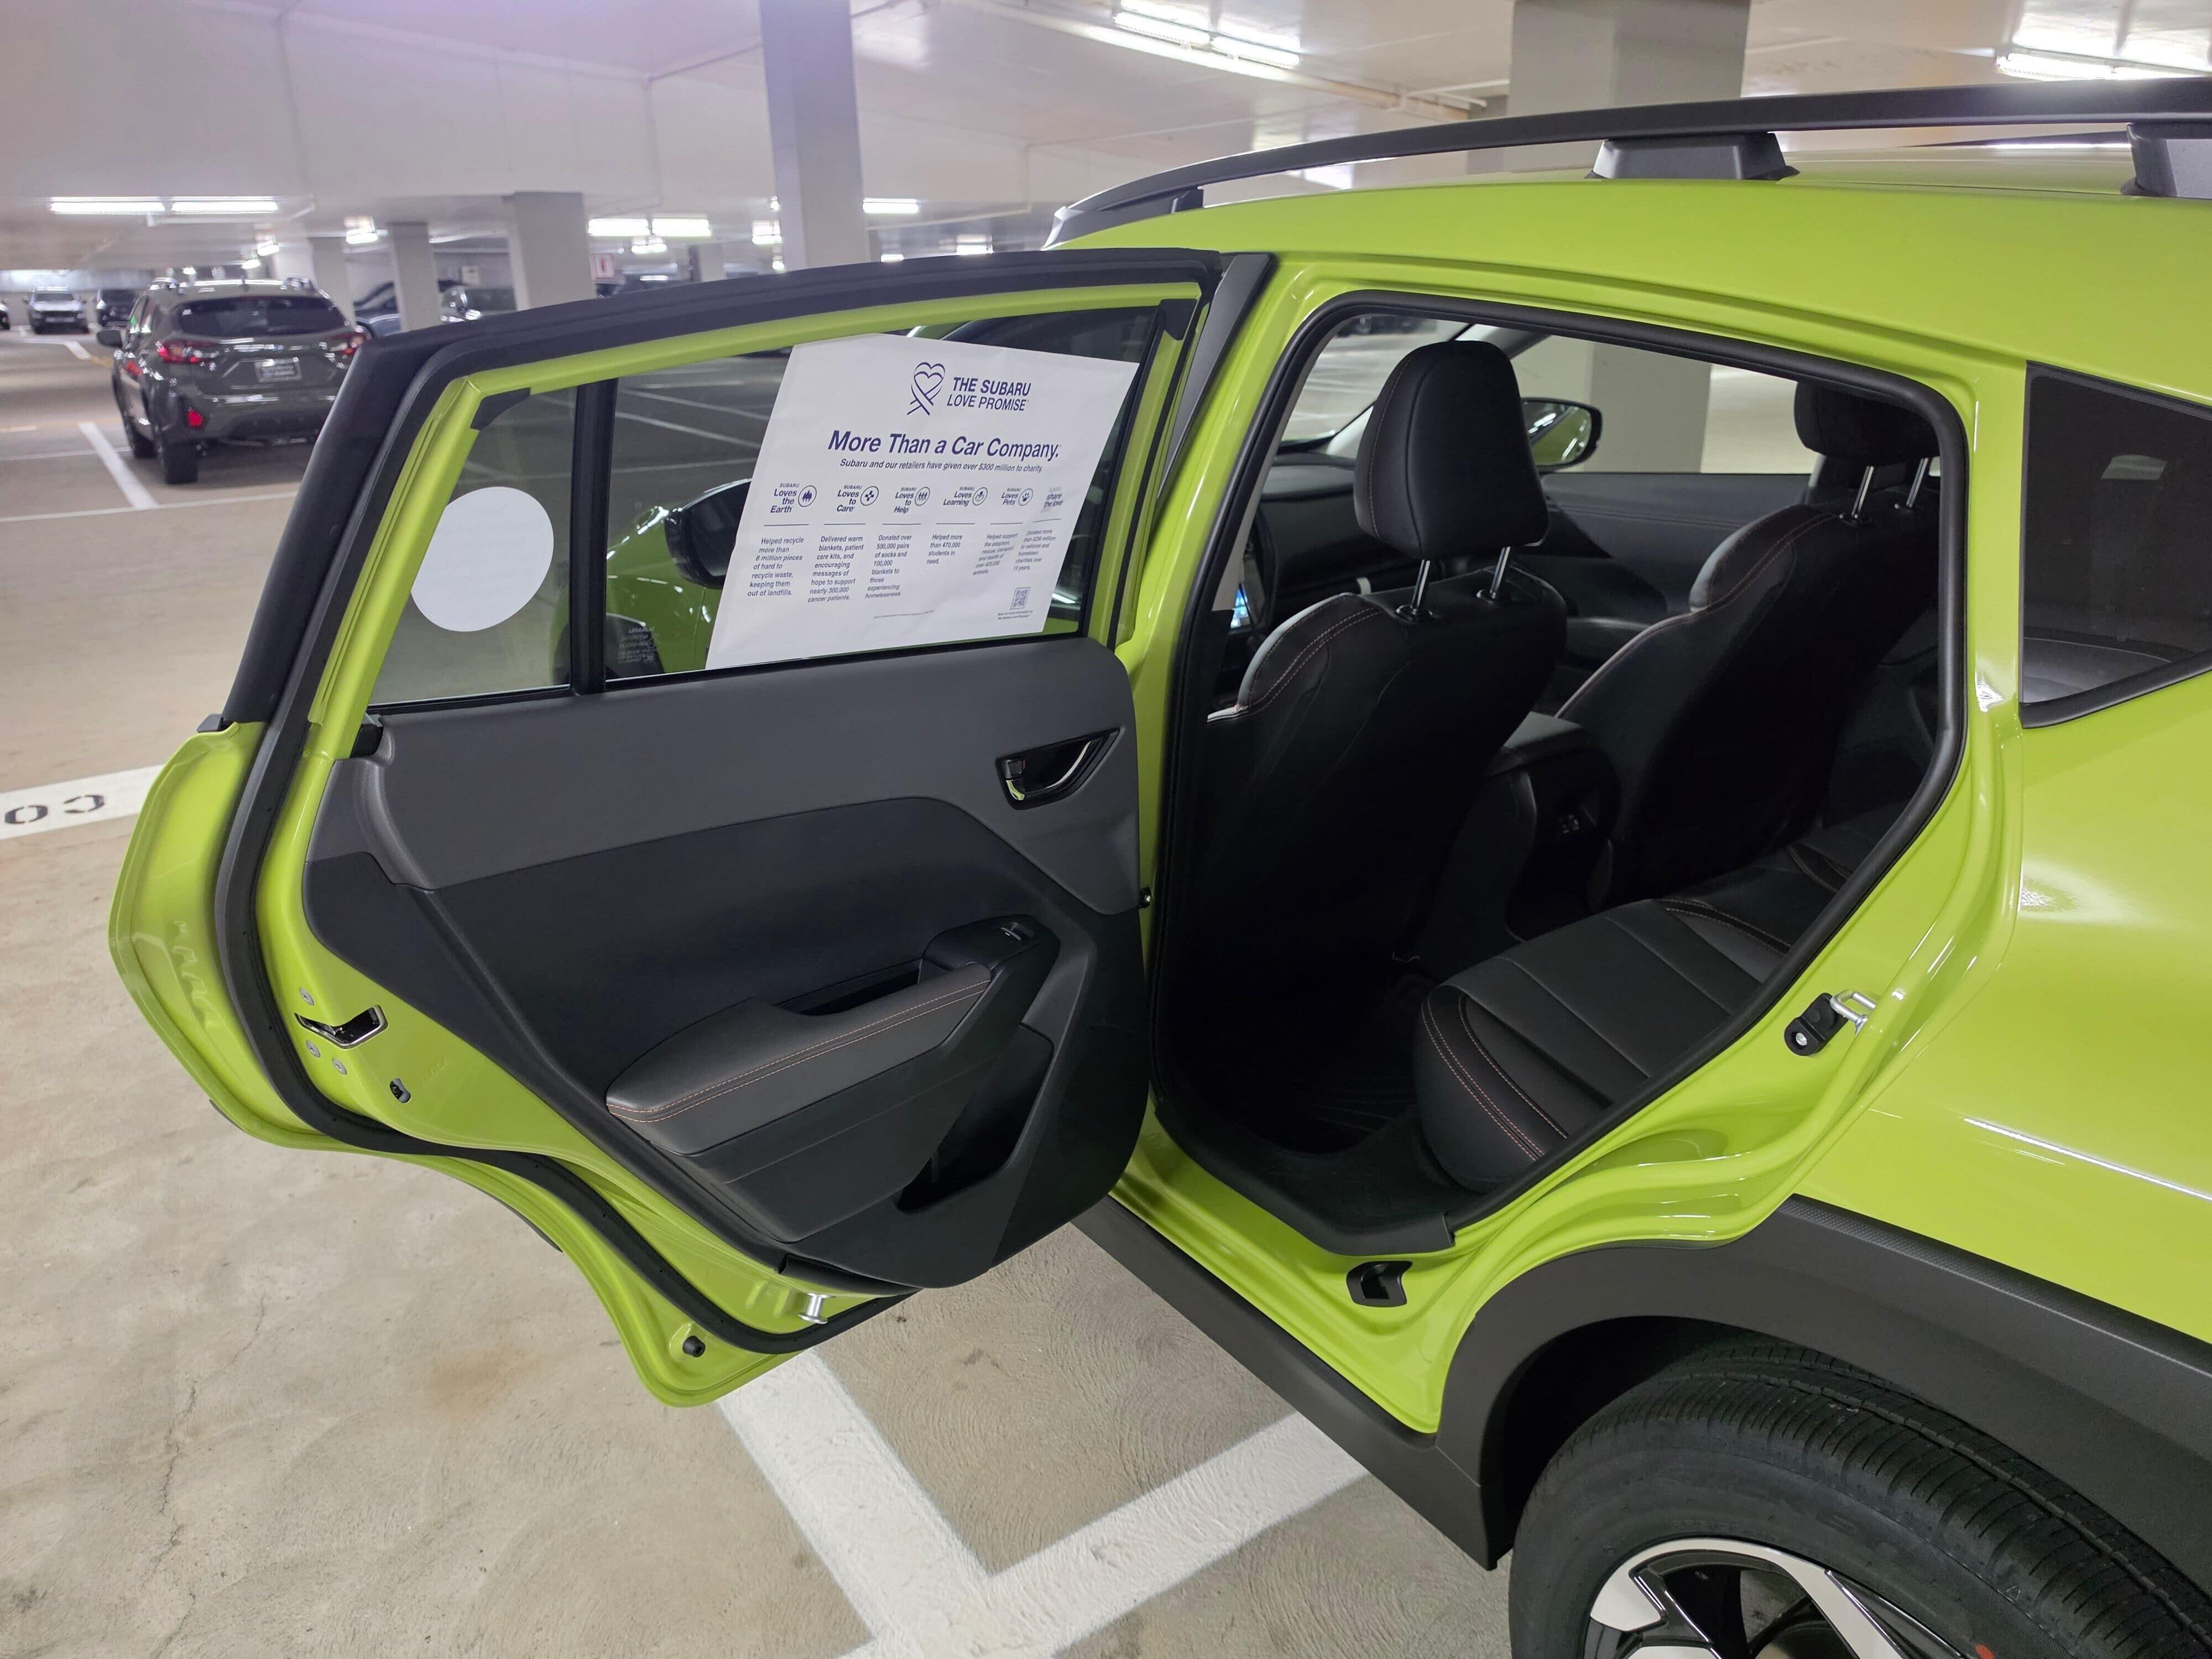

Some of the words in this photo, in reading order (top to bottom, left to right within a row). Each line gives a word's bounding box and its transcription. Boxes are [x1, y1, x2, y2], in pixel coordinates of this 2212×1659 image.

[953, 377, 978, 392] THE
[980, 379, 1031, 397] SUBARU
[947, 394, 977, 408] LOVE
[978, 397, 1026, 411] PROMISE
[828, 430, 881, 452] More
[889, 434, 931, 453] Than
[935, 440, 947, 454] a
[952, 436, 984, 456] Car
[987, 438, 1058, 462] Company.
[840, 458, 868, 467] Subaru
[943, 462, 962, 471] given
[1023, 465, 1043, 474] charity.
[894, 506, 909, 514] Help
[761, 538, 782, 546] Helped
[783, 536, 804, 545] recycle
[752, 572, 774, 580] recycle
[749, 581, 774, 589] keeping
[827, 594, 851, 603] patients.
